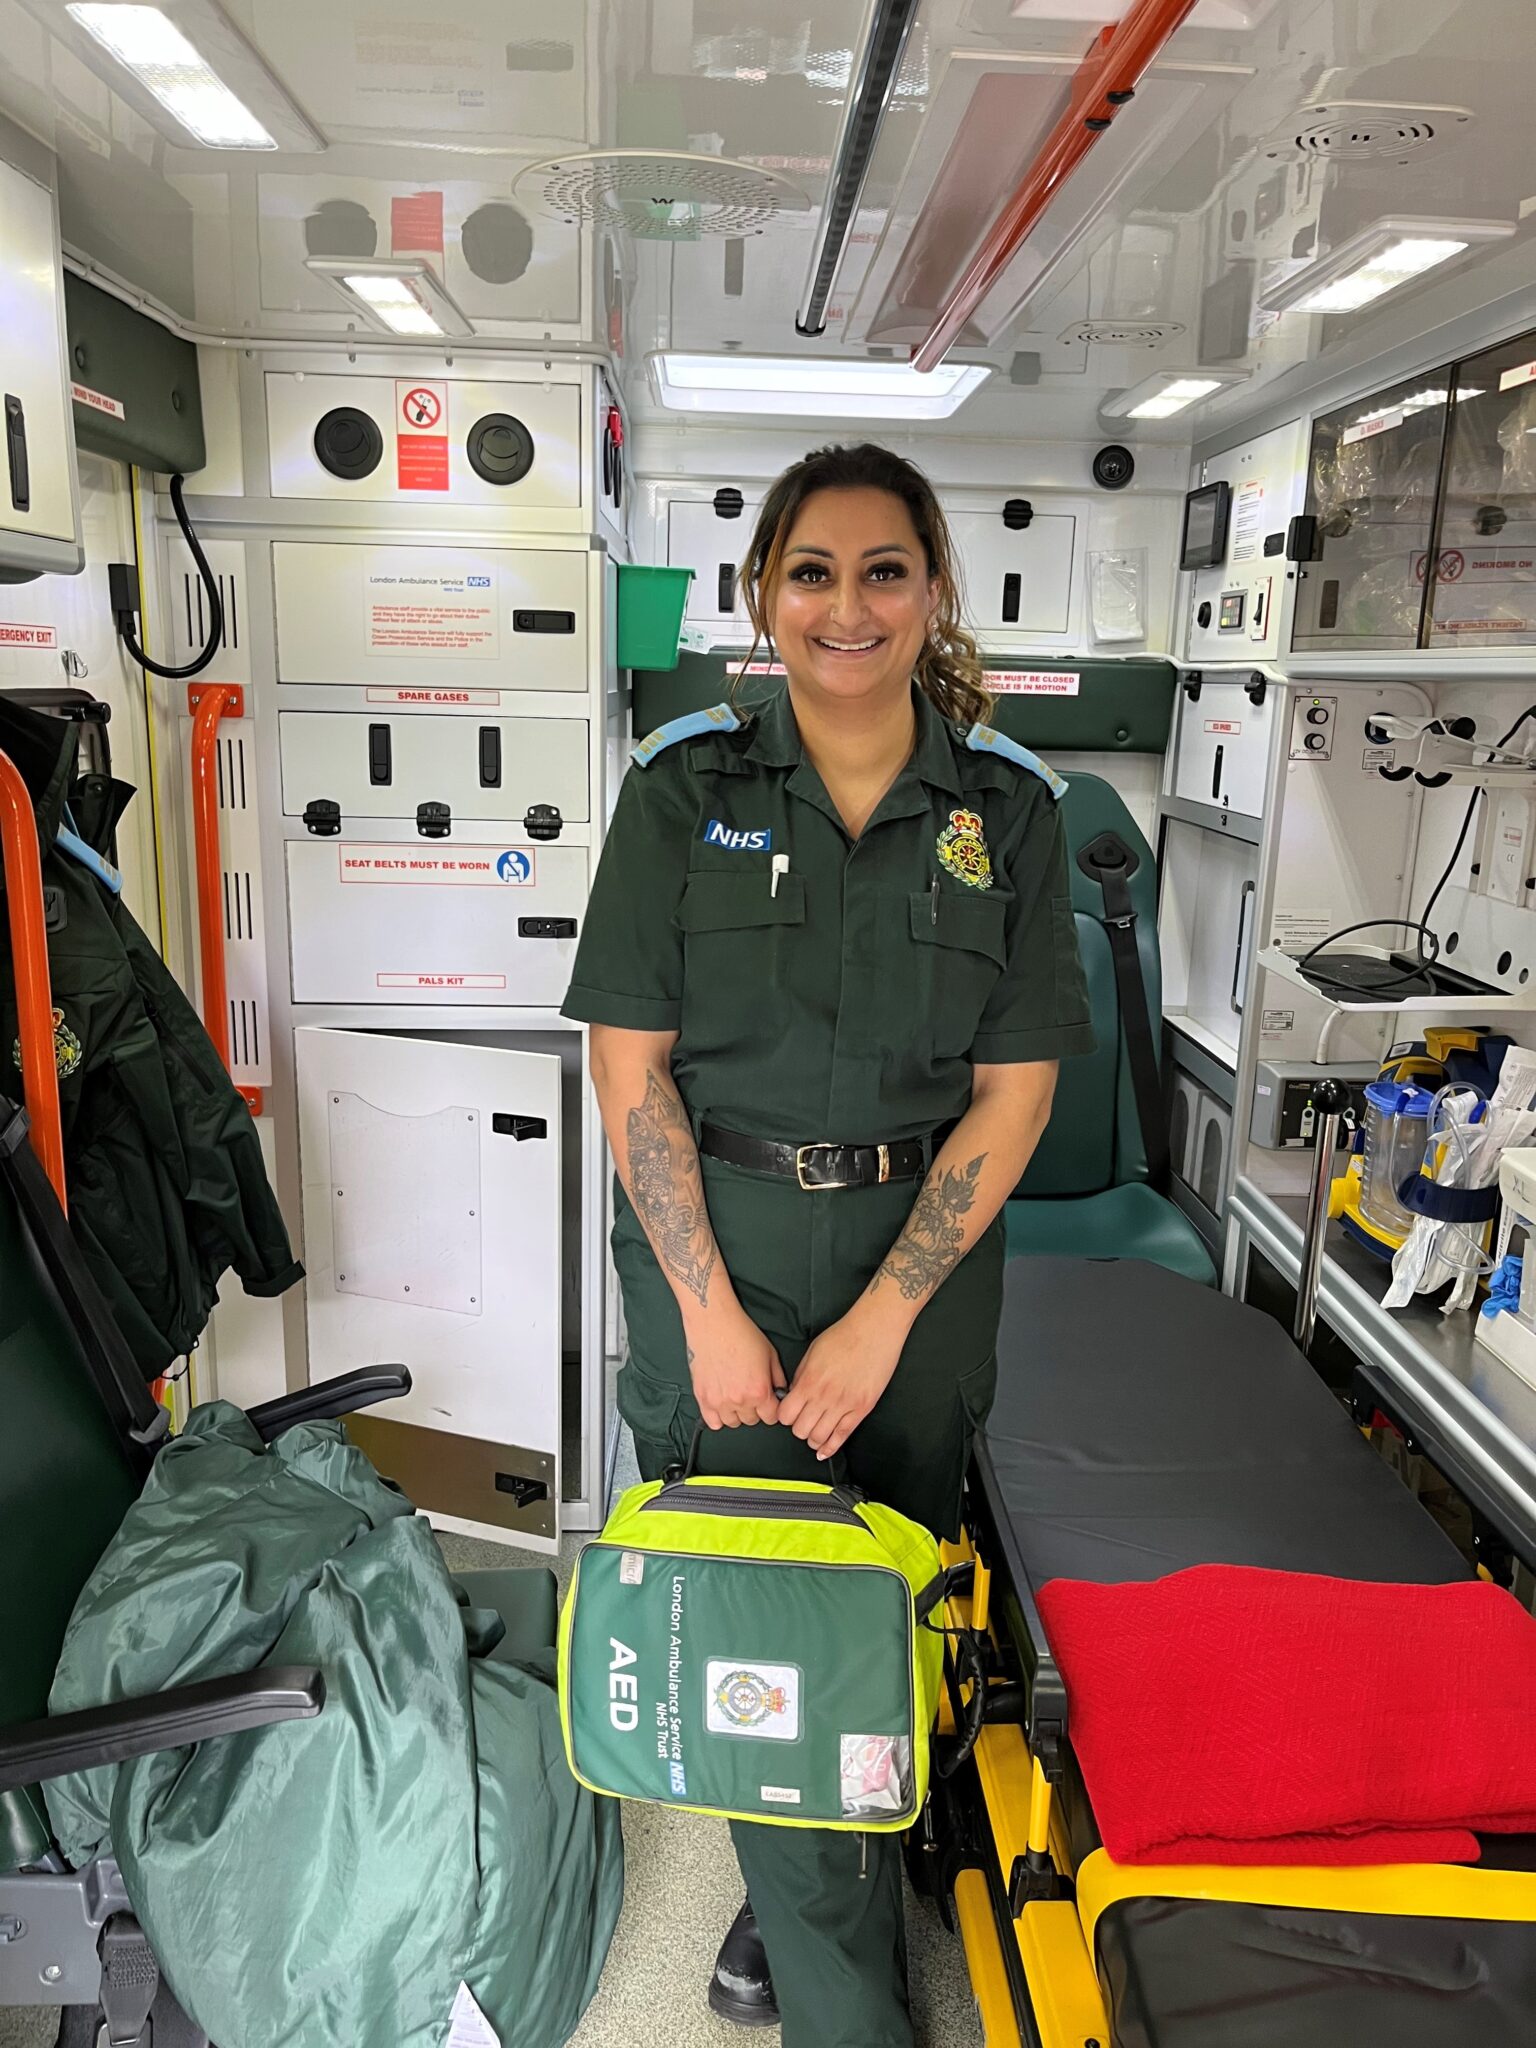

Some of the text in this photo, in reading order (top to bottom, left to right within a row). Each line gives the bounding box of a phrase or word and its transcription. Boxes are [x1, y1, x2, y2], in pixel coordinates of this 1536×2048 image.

[88, 392, 102, 406] YOUR
[102, 398, 116, 412] HEAD
[370, 576, 491, 587] London Ambulance Service NHS
[0, 628, 52, 643] ERGENCY EXIT
[1042, 676, 1075, 684] CLOSED
[982, 682, 1011, 690] HICLE
[1034, 684, 1067, 692] MOTION
[397, 691, 470, 702] SPARE GASES
[710, 822, 767, 849] NHS
[344, 859, 491, 871] SEAT BELTS MUST BE WORN
[418, 977, 465, 985] PALS KIT
[609, 1636, 639, 1732] AED
[668, 1575, 687, 1795] London Ambulance Service NHS
[655, 1702, 670, 1759] NHS Trust
